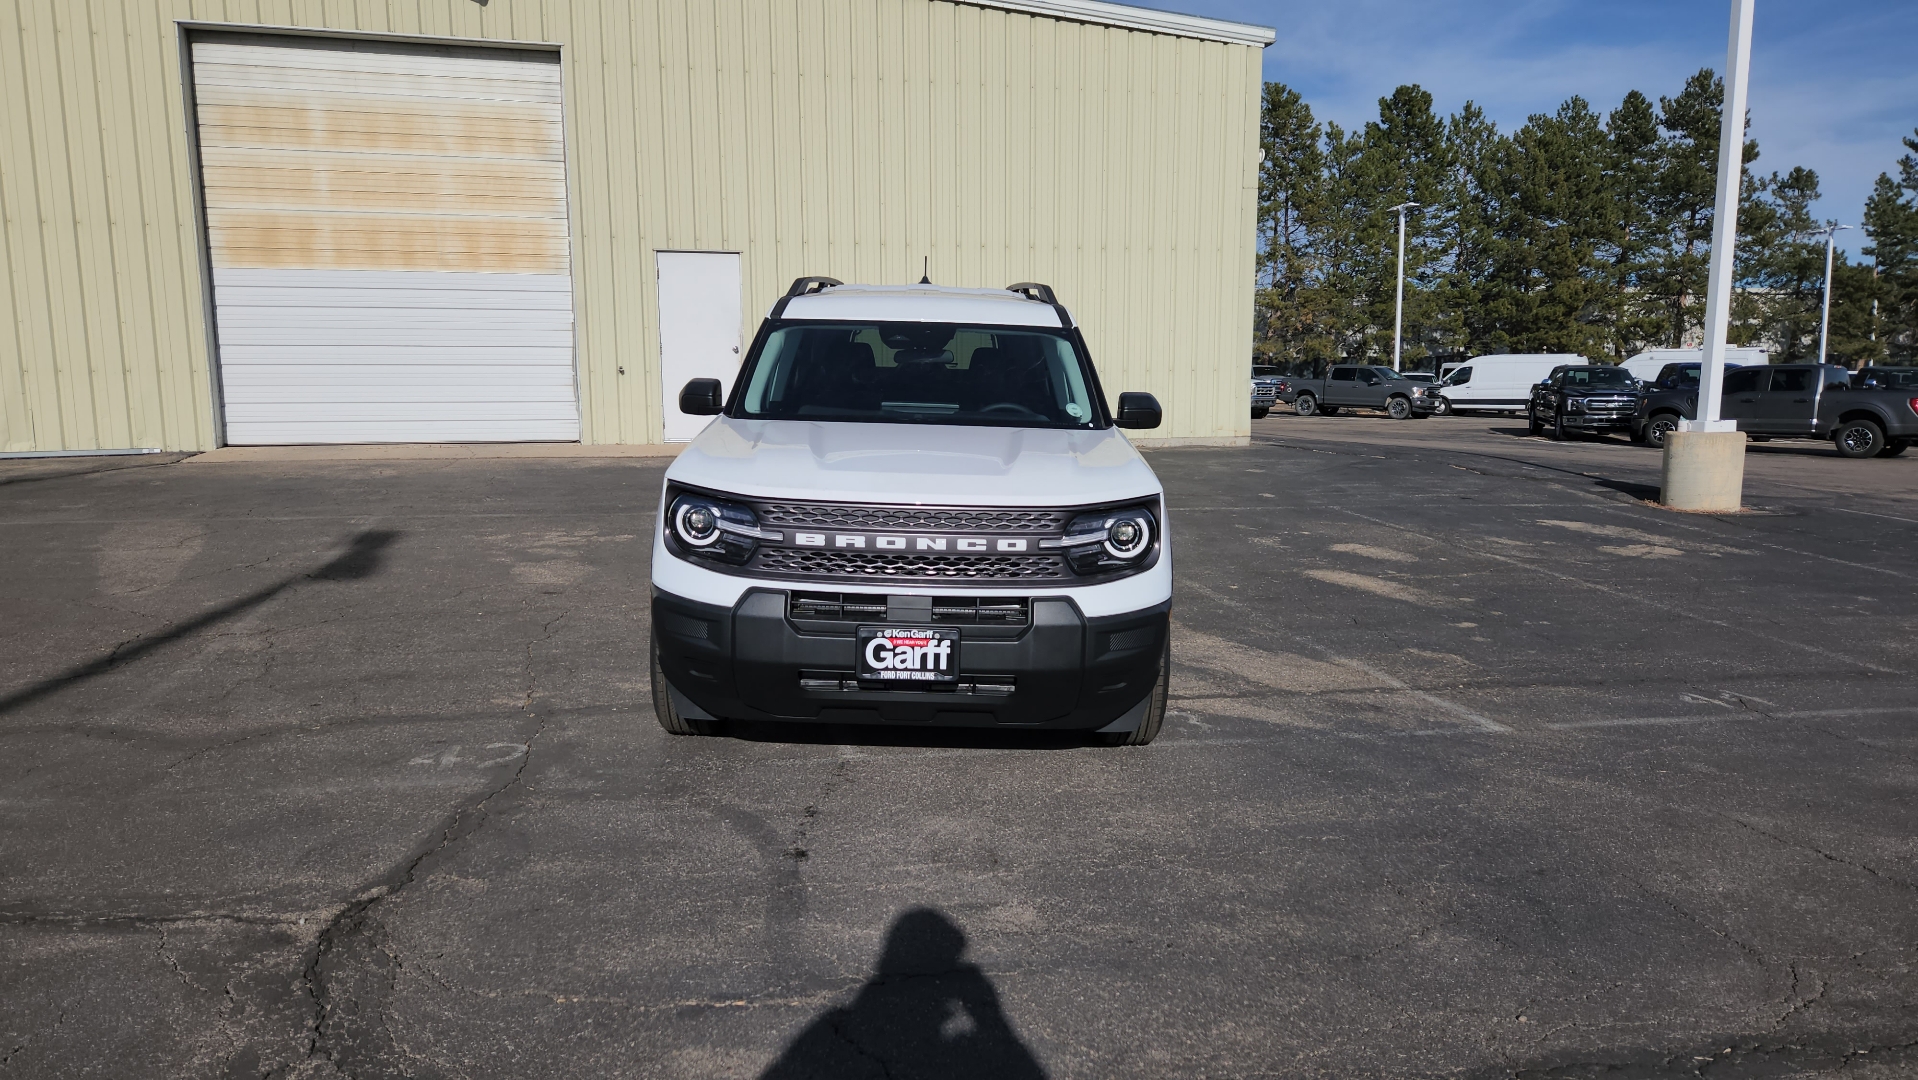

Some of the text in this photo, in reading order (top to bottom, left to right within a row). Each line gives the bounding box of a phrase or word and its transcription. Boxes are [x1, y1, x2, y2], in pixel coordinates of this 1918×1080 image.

[795, 532, 1027, 552] BRONCO
[892, 630, 934, 639] Ken Garff
[866, 638, 950, 669] Garff
[880, 671, 935, 680] FORD FORT COLLINS
